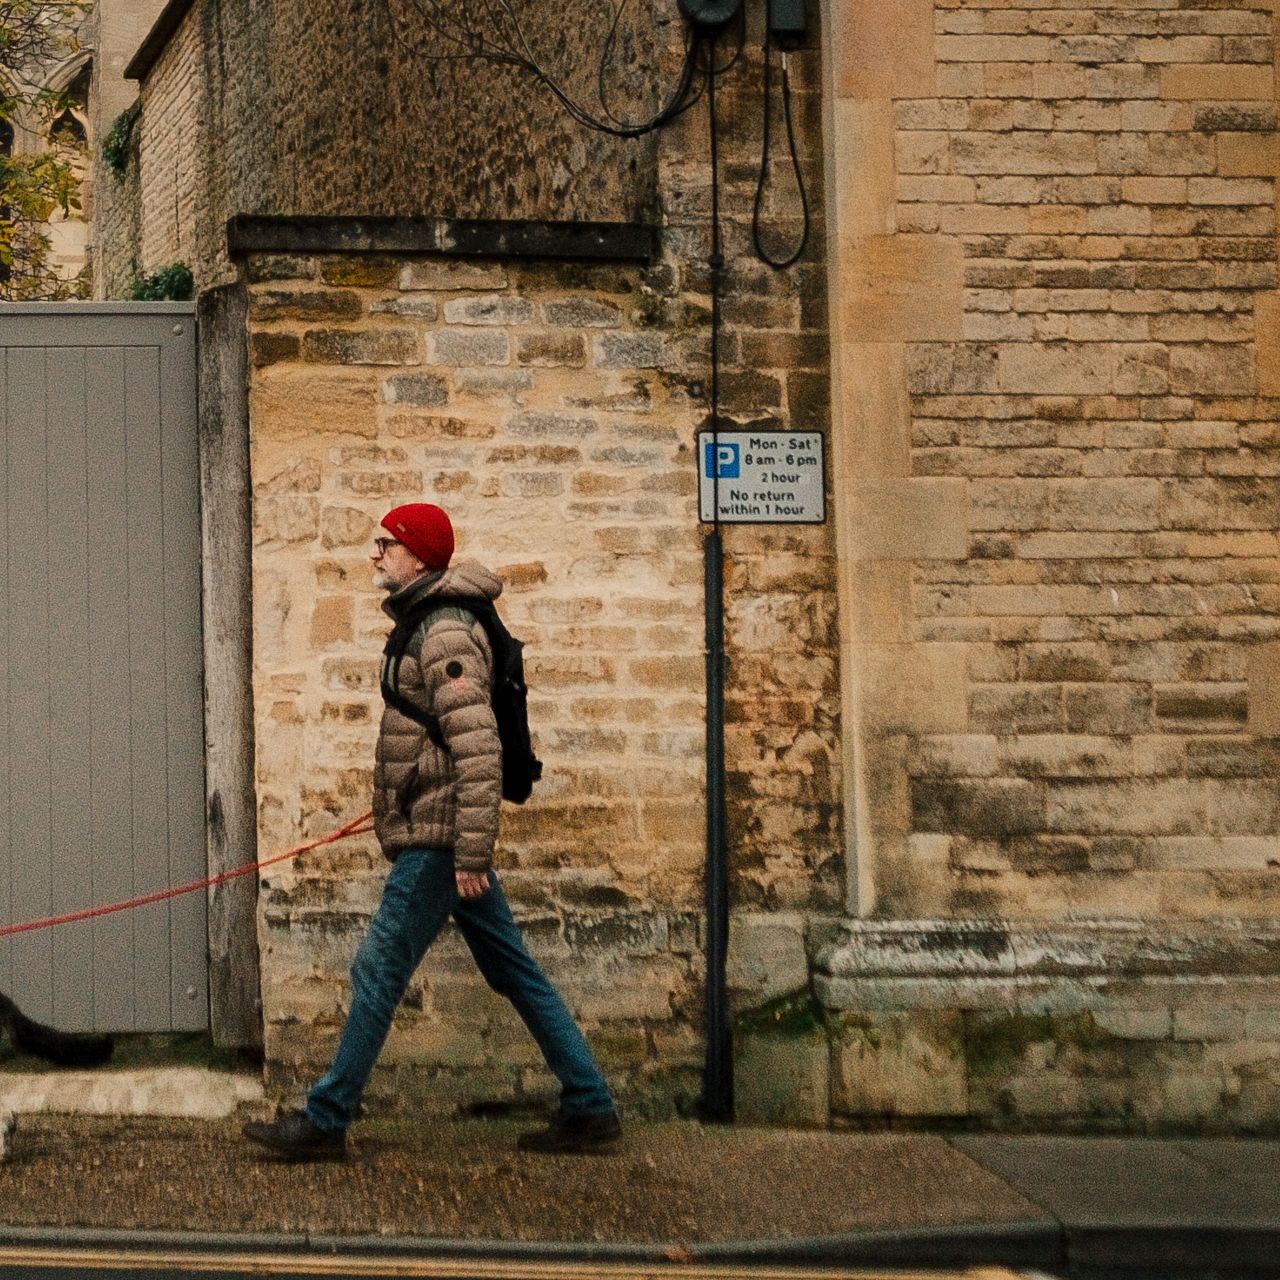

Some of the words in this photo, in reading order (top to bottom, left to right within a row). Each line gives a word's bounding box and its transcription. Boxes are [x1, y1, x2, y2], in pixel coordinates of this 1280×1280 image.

[749, 438, 778, 450] Mon
[789, 438, 812, 450] Sat
[717, 447, 735, 475] P
[745, 454, 754, 466] 8
[756, 457, 776, 466] am
[786, 454, 795, 466] 6
[797, 457, 818, 467] pm
[761, 472, 769, 483] 2
[771, 472, 802, 483] hour
[730, 489, 749, 501] No
[753, 491, 795, 502] return
[719, 503, 761, 515] within
[765, 504, 770, 515] 1
[775, 504, 805, 515] hour
